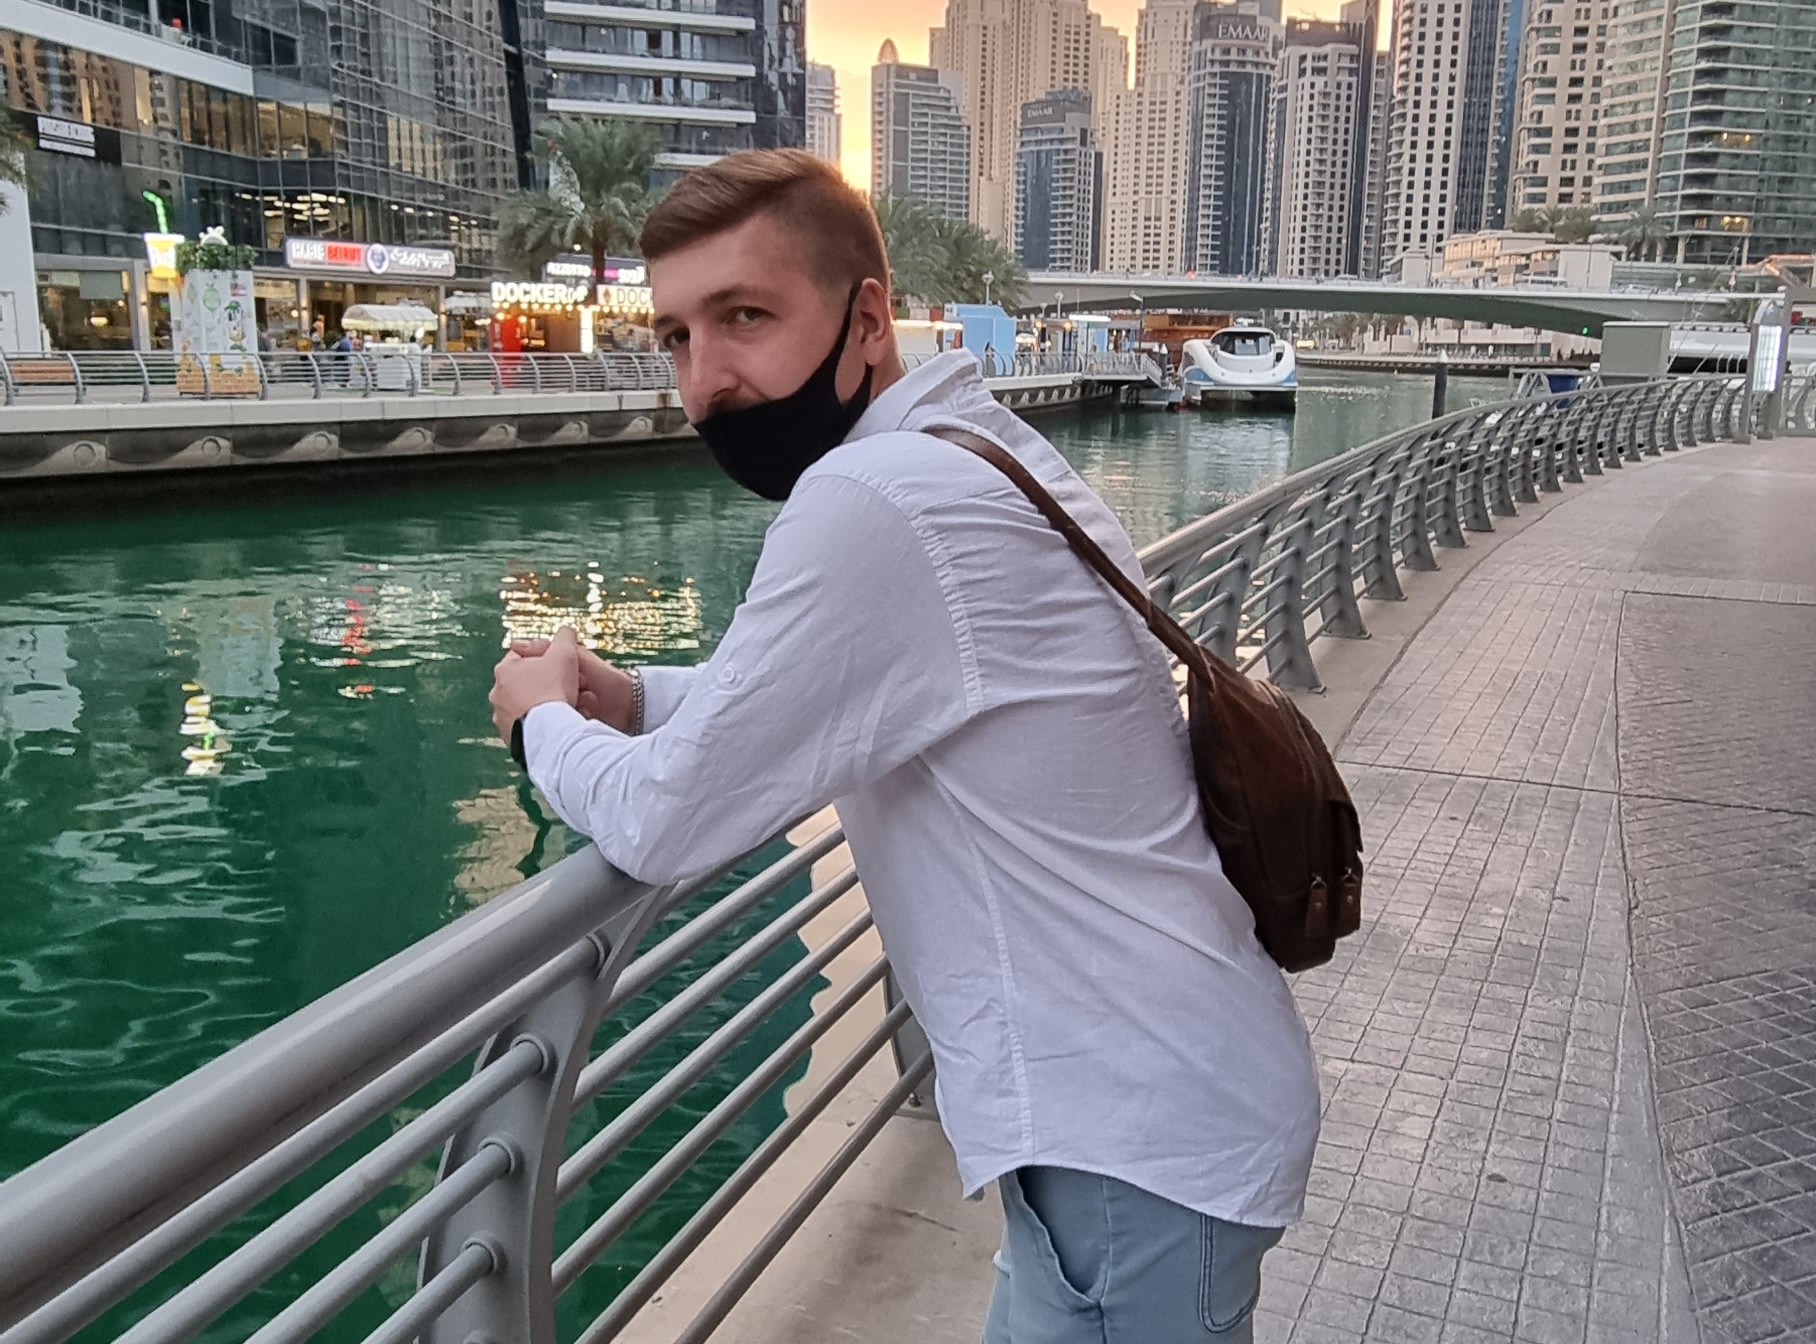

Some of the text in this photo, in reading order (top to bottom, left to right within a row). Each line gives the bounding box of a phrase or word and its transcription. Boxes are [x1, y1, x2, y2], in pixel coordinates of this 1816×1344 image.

[1218, 24, 1269, 40] EMAAR
[327, 245, 362, 262] BEIRUT
[491, 282, 568, 304] DOCKER
[617, 288, 653, 305] DOC
